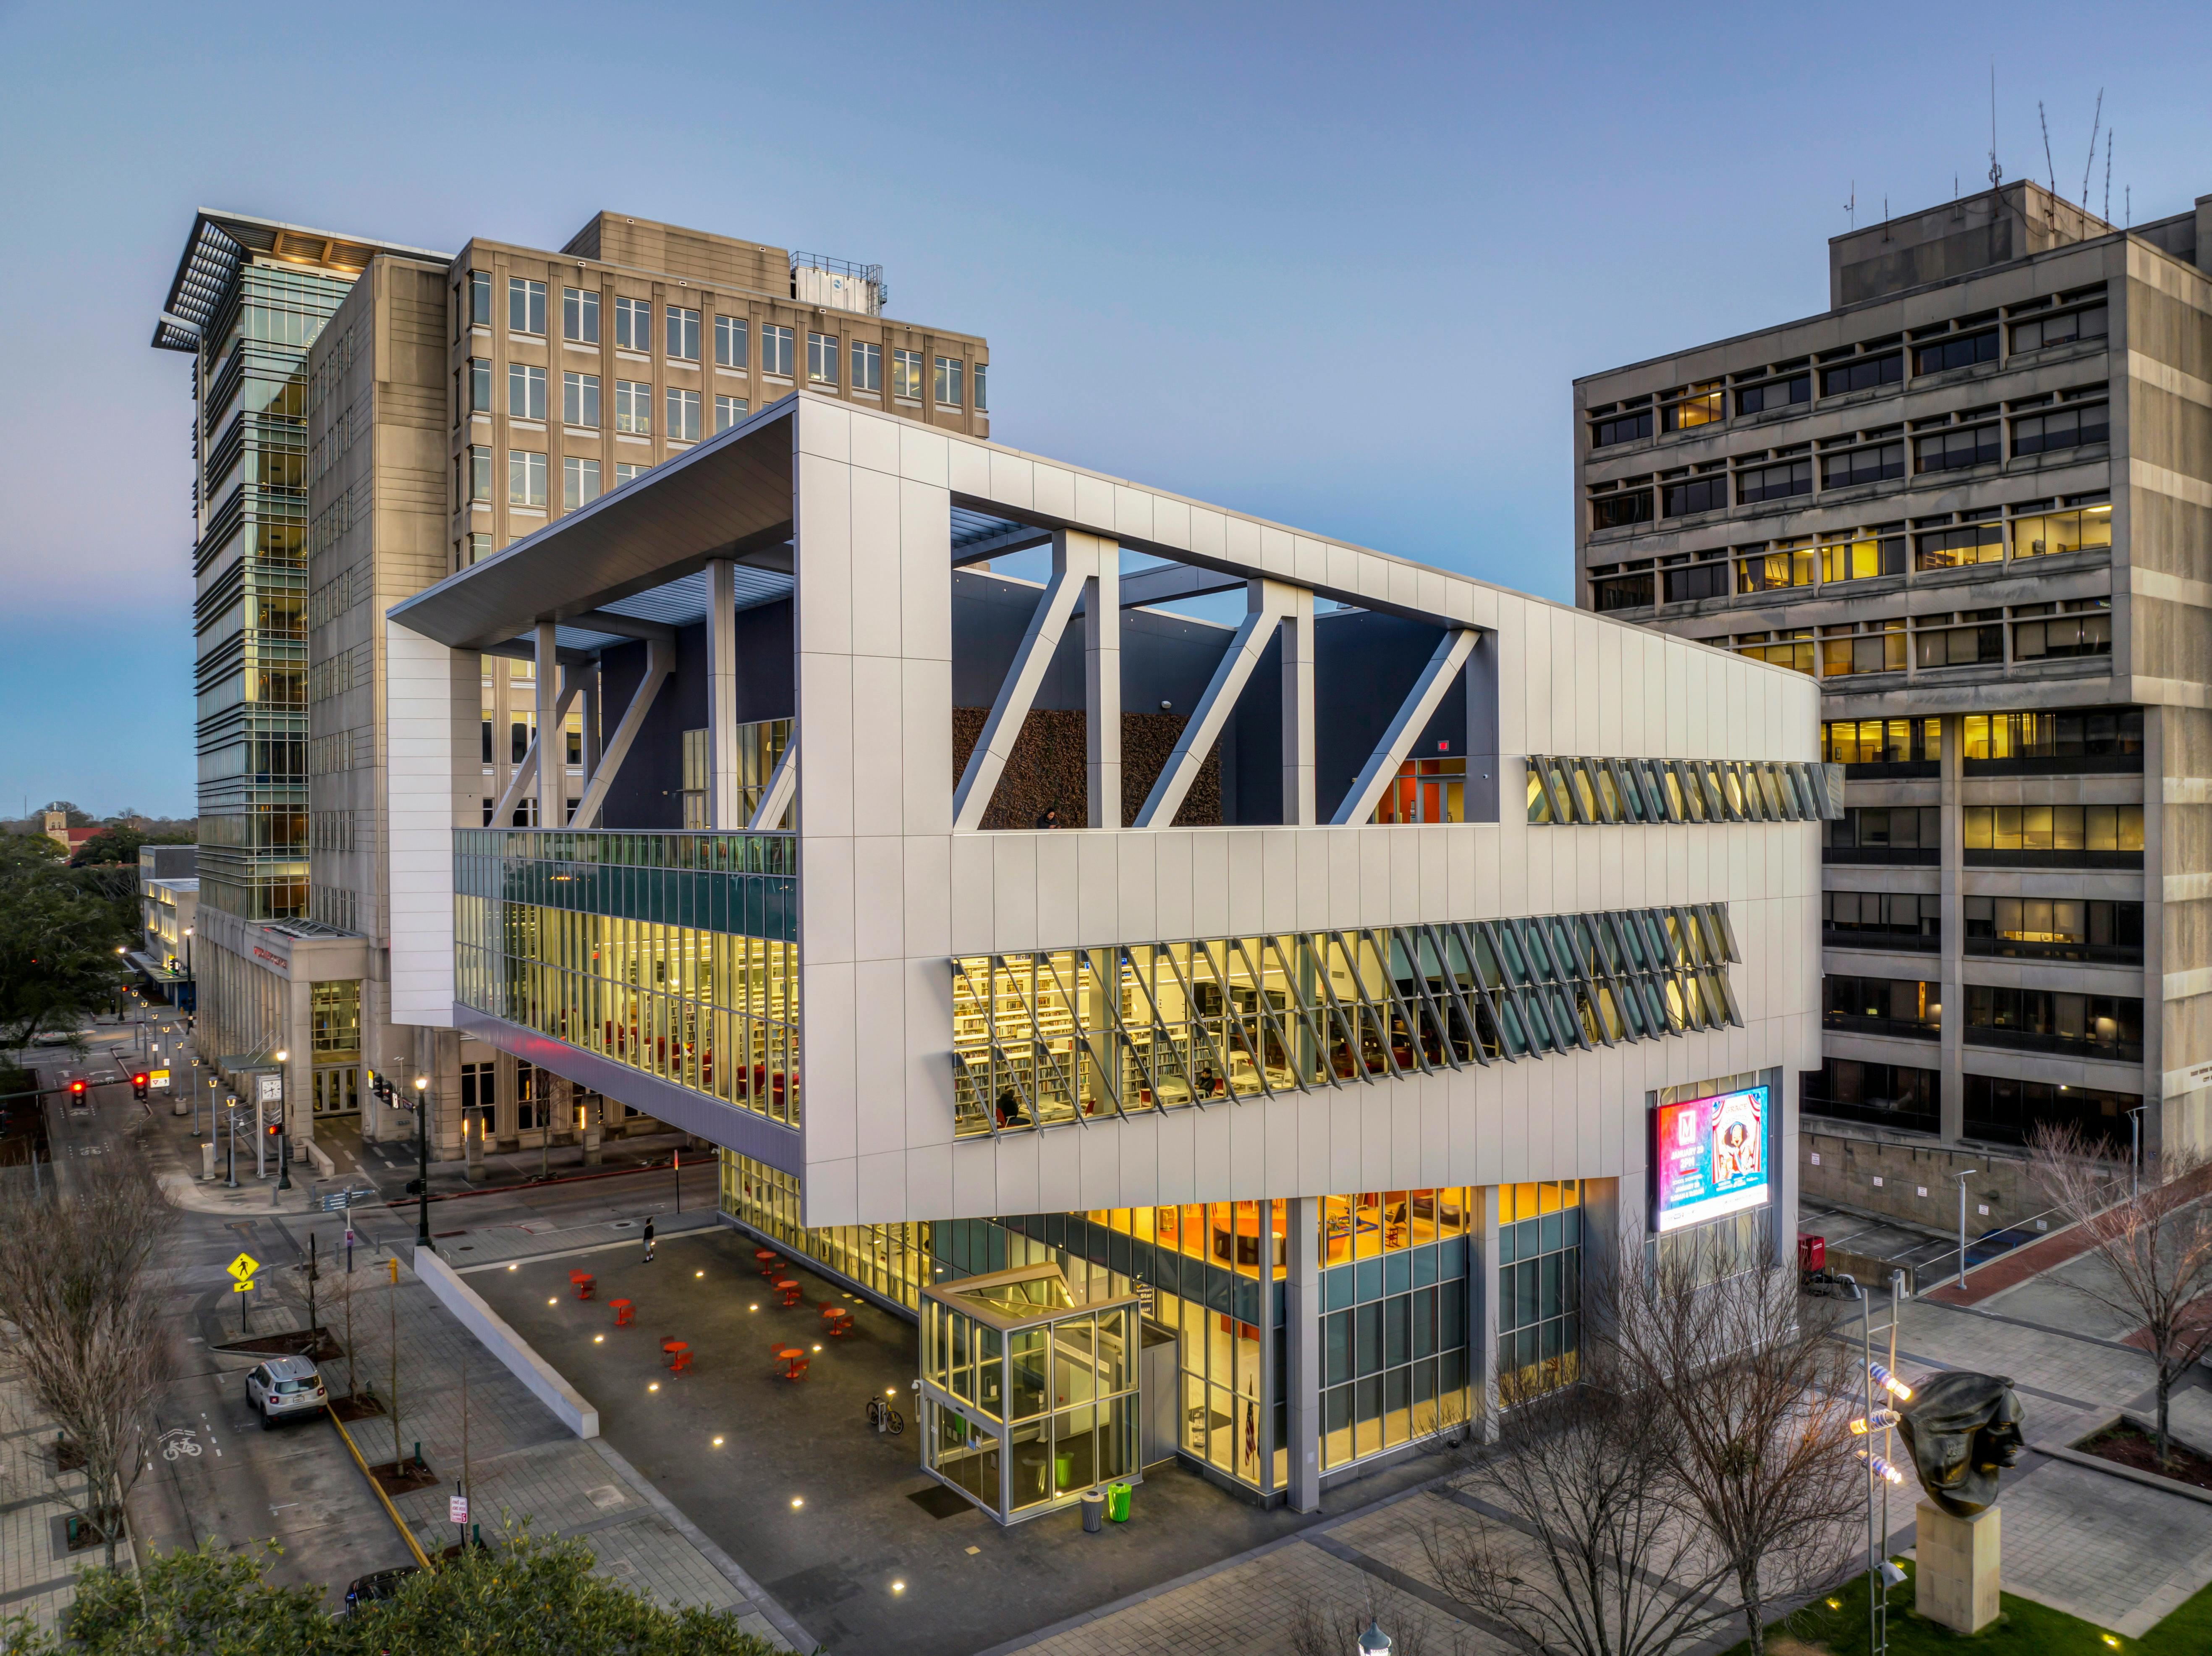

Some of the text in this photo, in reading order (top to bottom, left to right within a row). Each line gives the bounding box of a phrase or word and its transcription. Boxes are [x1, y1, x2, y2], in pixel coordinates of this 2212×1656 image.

[1725, 1103, 1748, 1114] GRACE
[1671, 1147, 1696, 1159] JANUARY
[1680, 1156, 1695, 1169] 2PM
[1675, 1183, 1694, 1193] JANUARY
